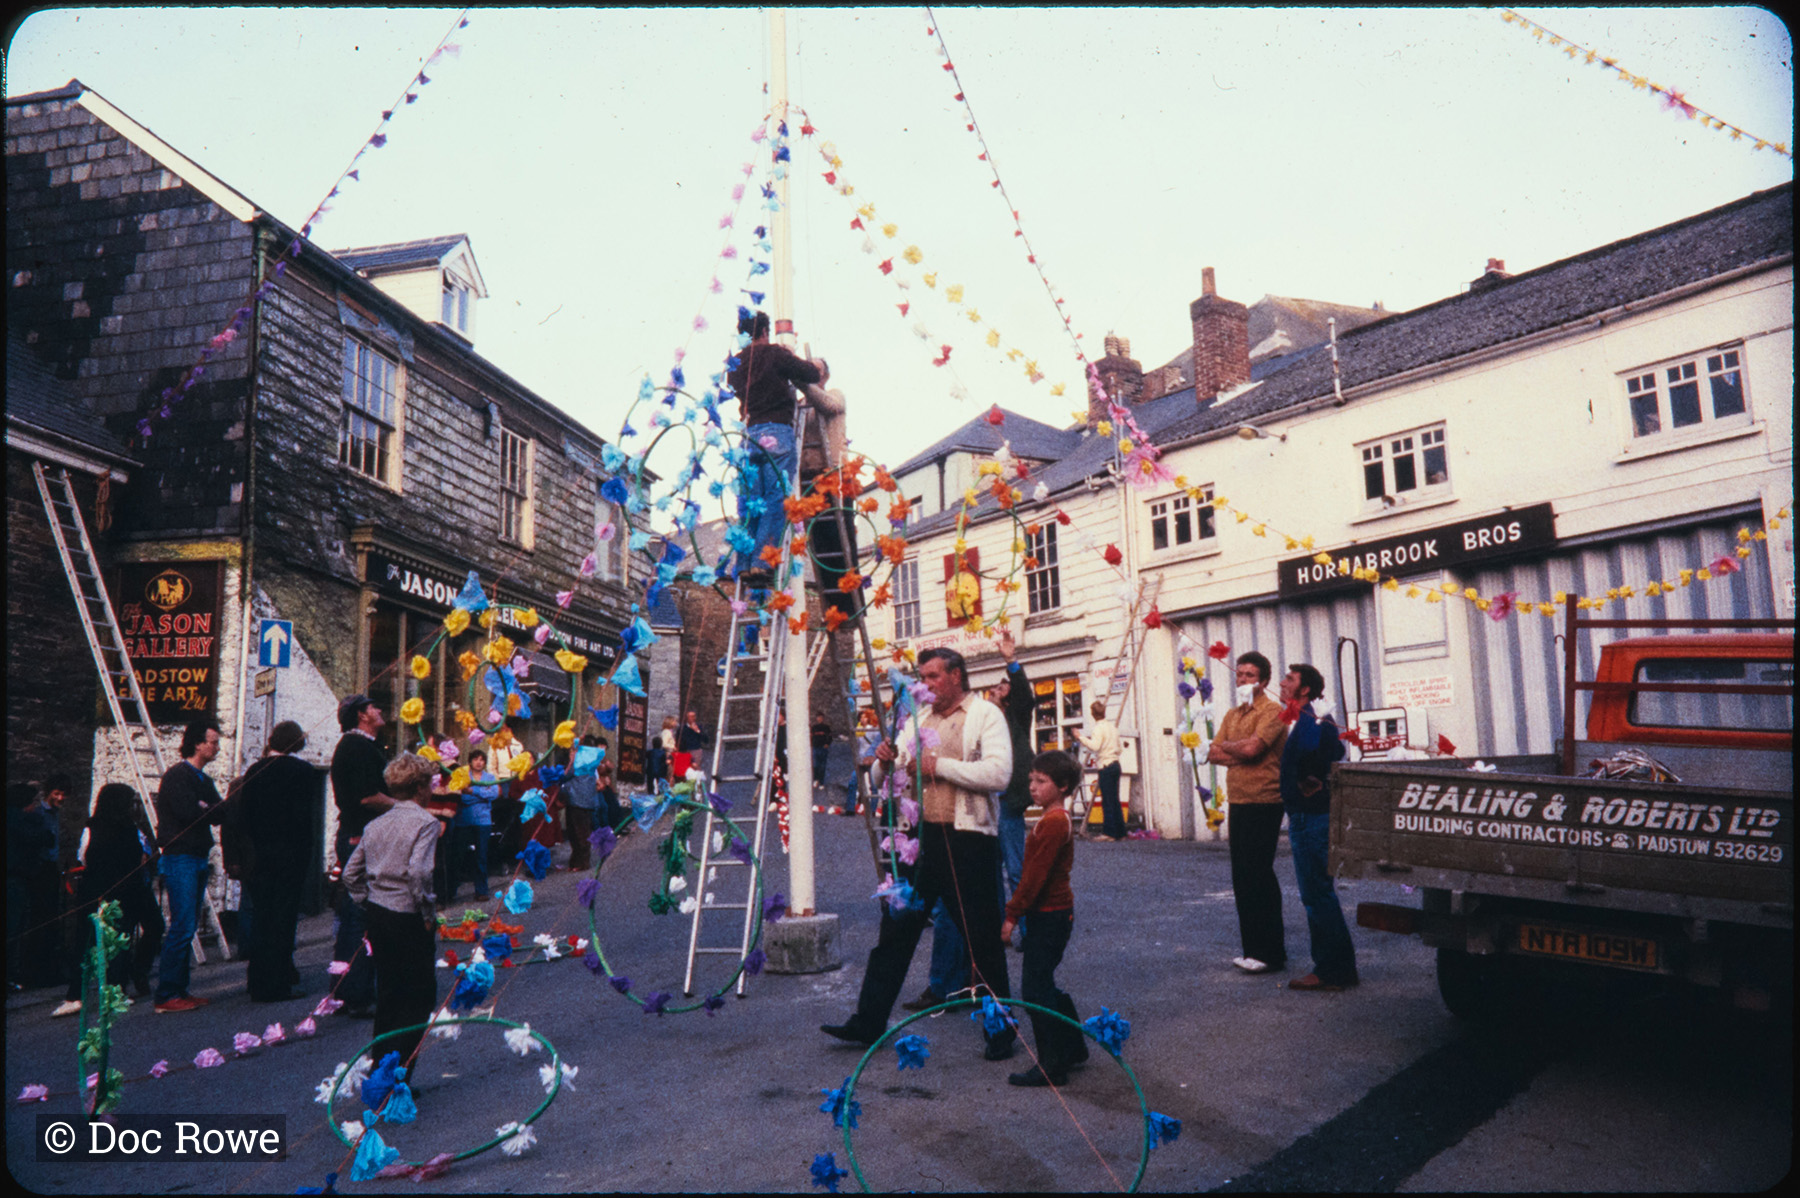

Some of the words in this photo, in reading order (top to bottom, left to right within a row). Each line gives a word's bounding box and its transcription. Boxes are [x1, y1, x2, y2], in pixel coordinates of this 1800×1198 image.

[1297, 539, 1438, 584] HORNABROOK
[1463, 521, 1522, 550] BROS
[401, 570, 458, 605] JASON
[125, 613, 212, 635] JASON
[964, 624, 1011, 640] NATNAL
[124, 636, 214, 658] GALLERY
[574, 636, 588, 650] FINE
[590, 641, 601, 653] ART
[163, 686, 198, 701] ART
[1398, 783, 1538, 818] BEALING
[1542, 794, 1567, 821] &
[1581, 797, 1724, 833] ROBERTS
[1728, 807, 1781, 837] LTD
[1395, 814, 1473, 836] BUILDING
[1714, 841, 1783, 863] 532629
